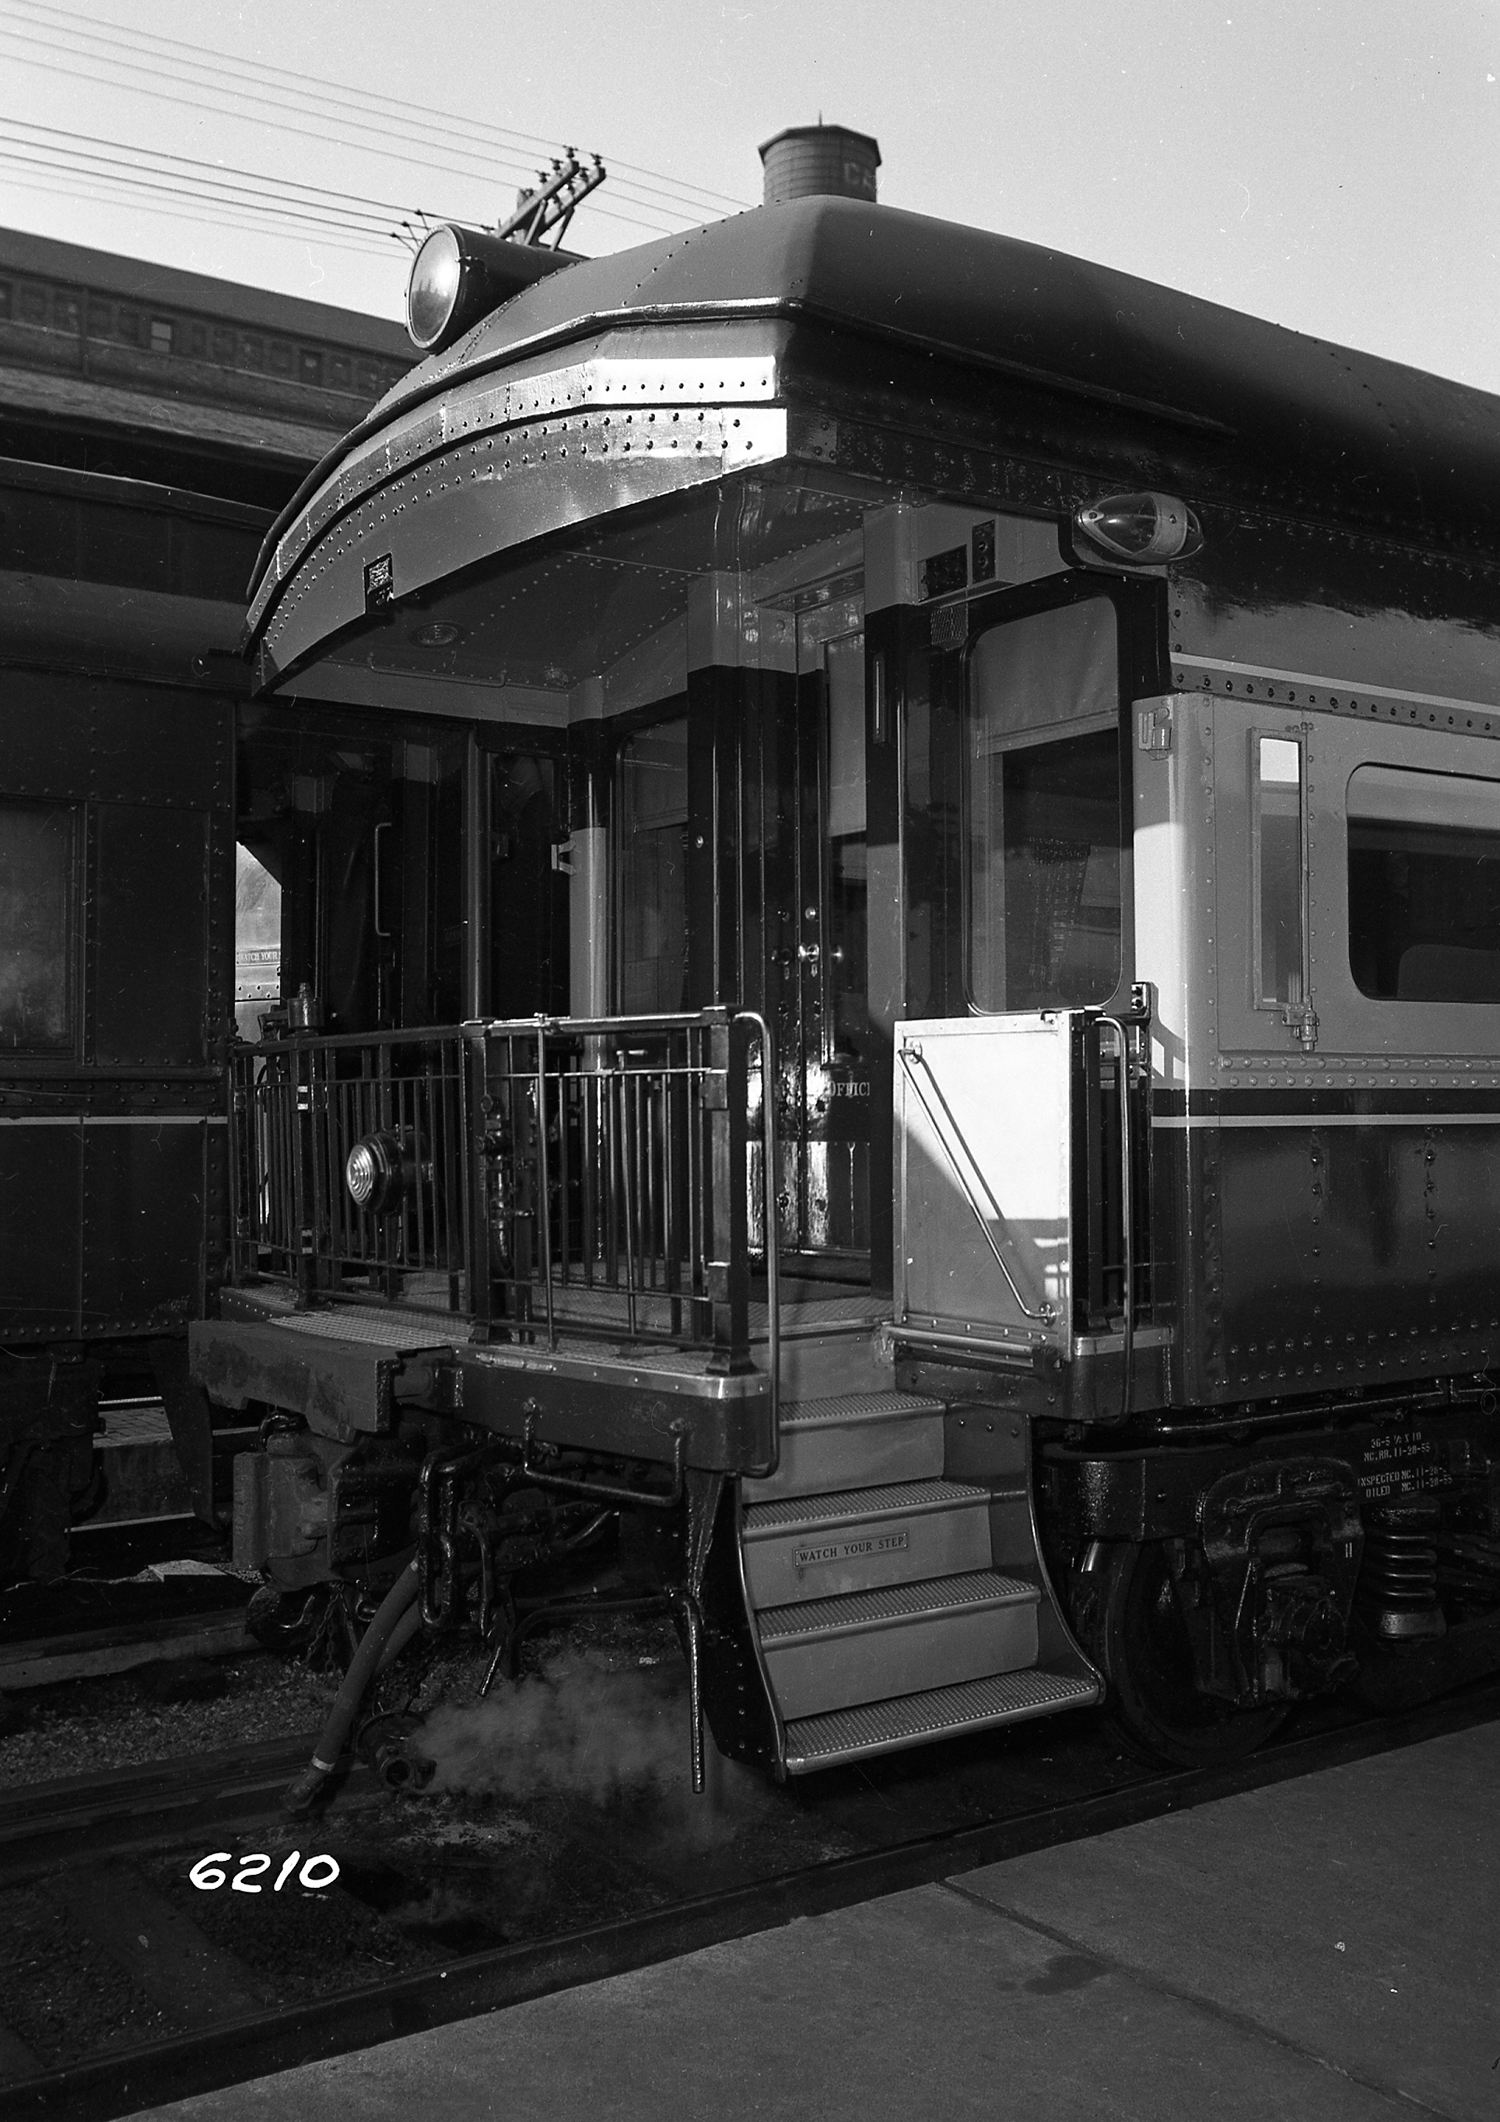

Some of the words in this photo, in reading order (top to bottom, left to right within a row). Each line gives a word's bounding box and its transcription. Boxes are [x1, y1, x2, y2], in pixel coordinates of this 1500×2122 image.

[261, 951, 278, 961] YOUR
[1370, 1435, 1391, 1449] 36-5
[1412, 1431, 1422, 1442] 10
[1357, 1470, 1400, 1487] INSPECTED
[1365, 1485, 1391, 1498] OILED
[799, 1547, 838, 1562] WATCH
[844, 1541, 872, 1555] YOUR
[878, 1536, 904, 1549] STEP
